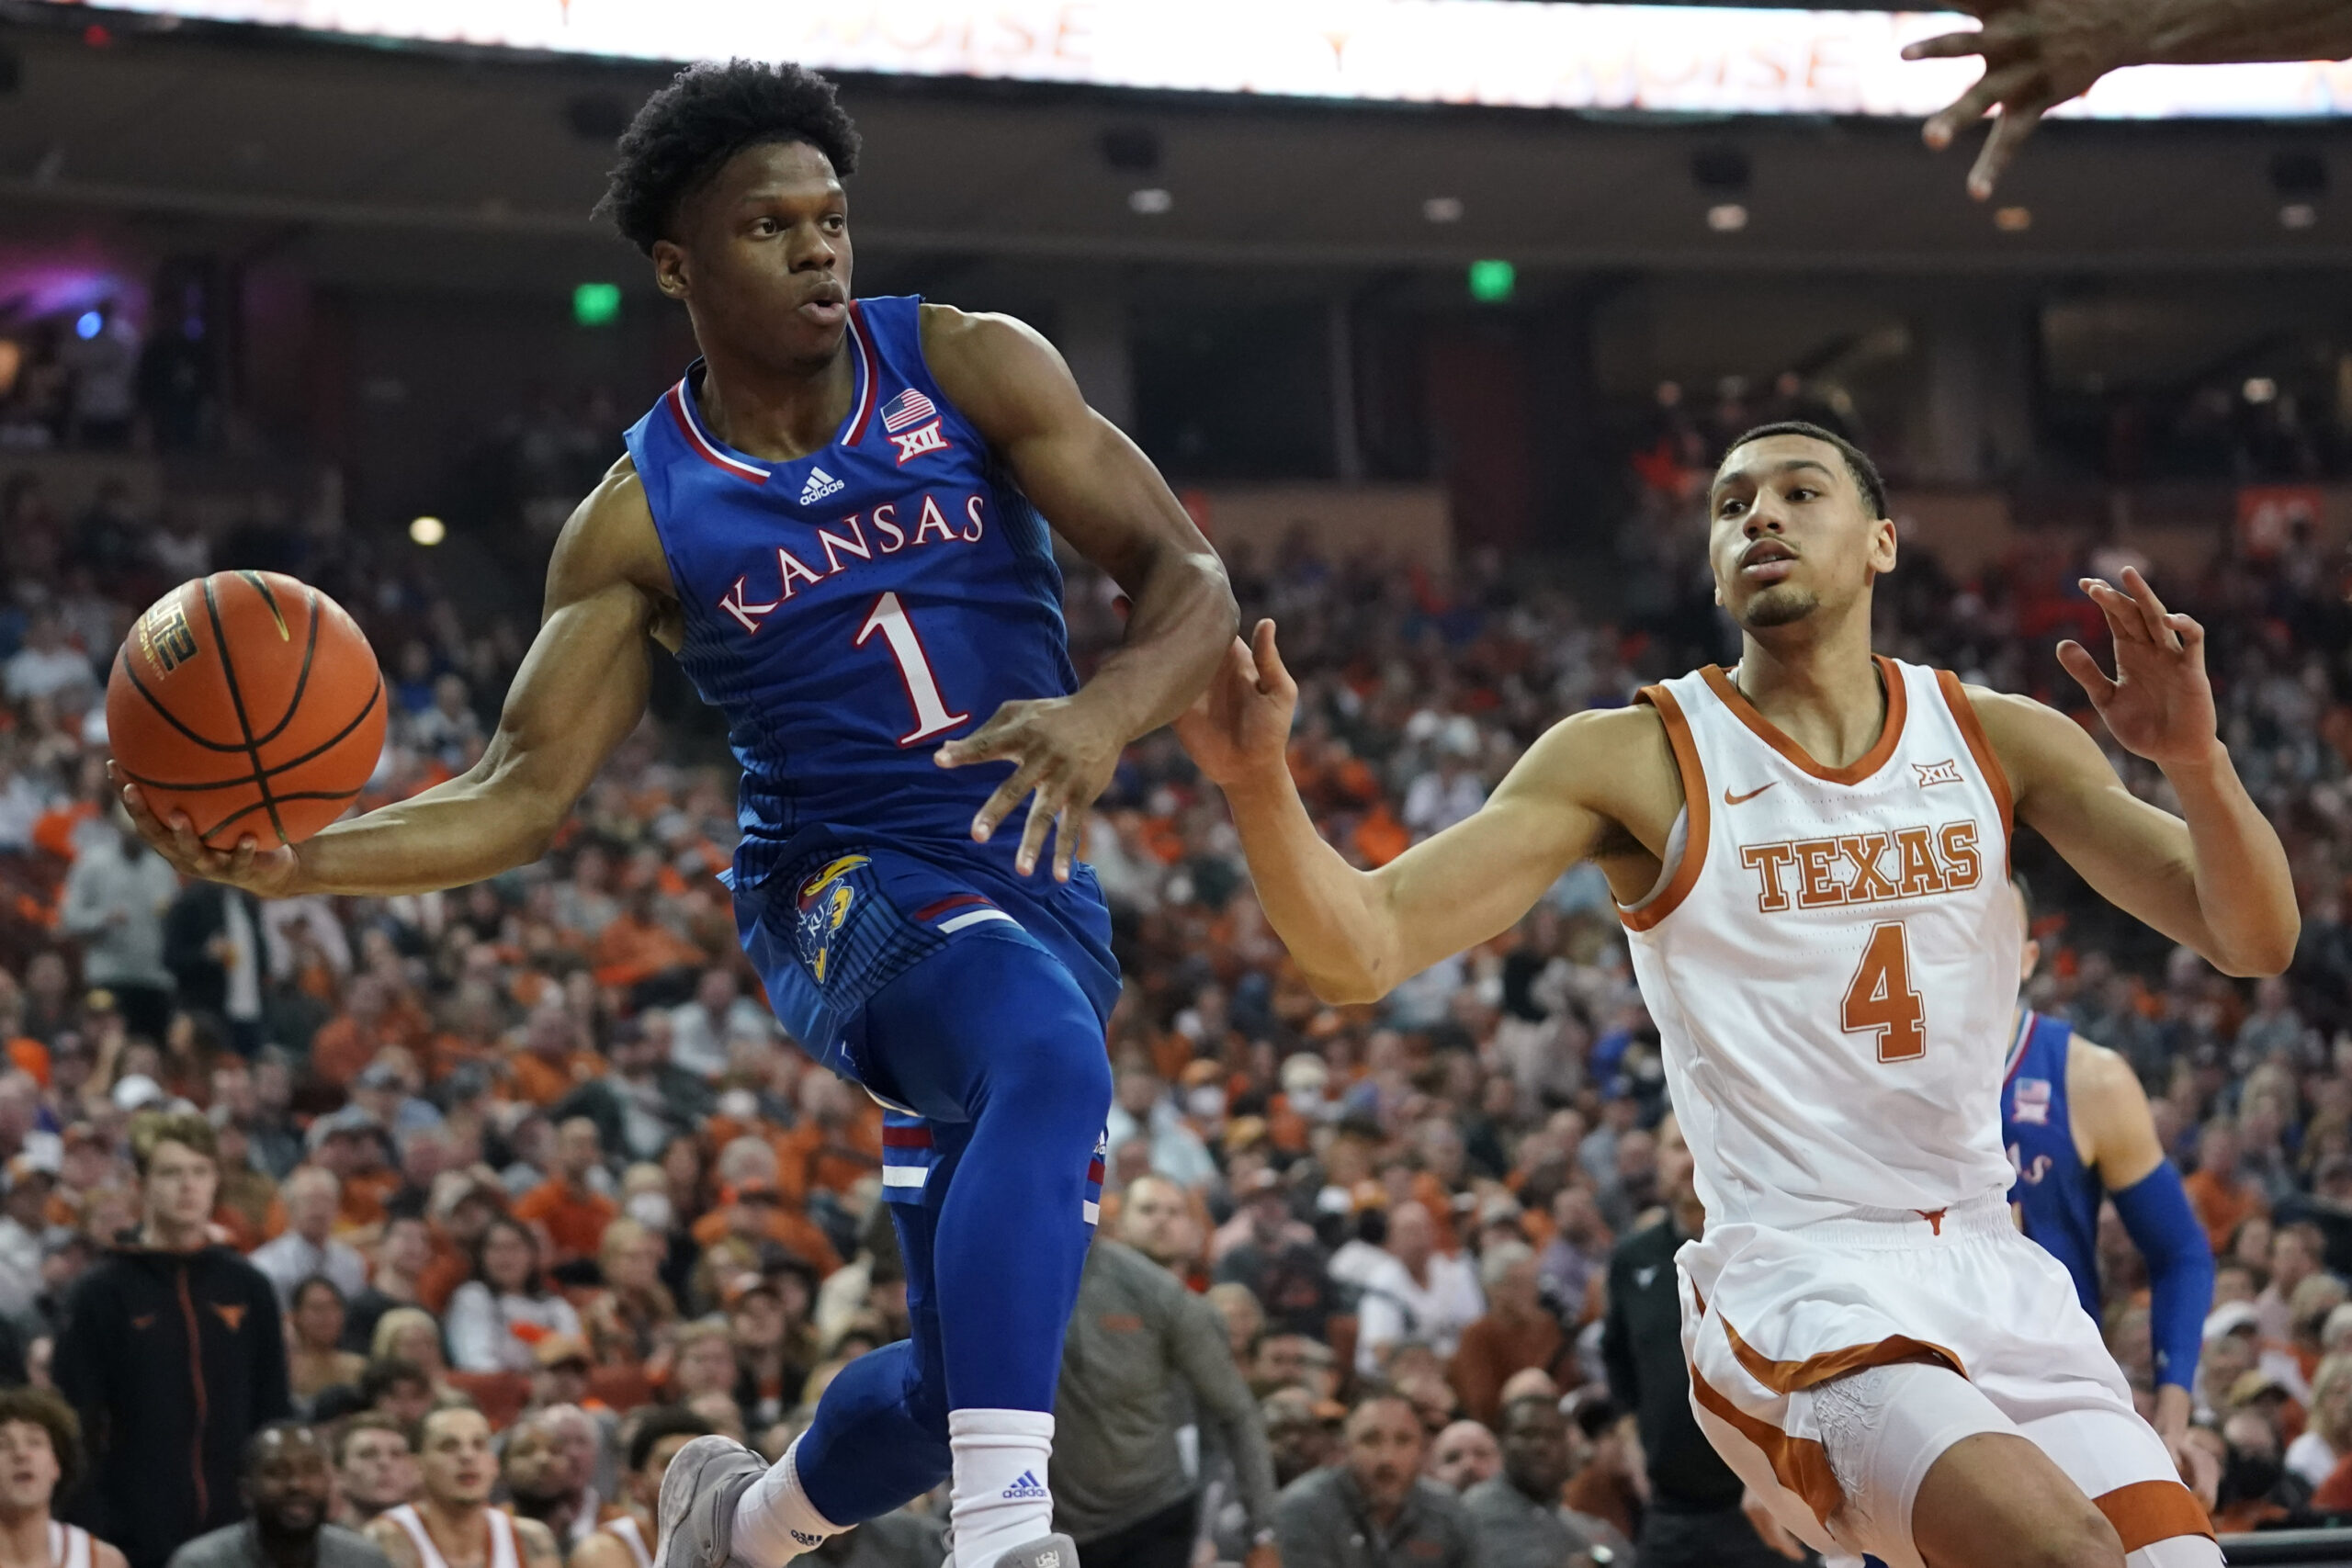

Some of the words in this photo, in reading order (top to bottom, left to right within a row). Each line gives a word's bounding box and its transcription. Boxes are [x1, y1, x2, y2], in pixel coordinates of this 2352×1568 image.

[886, 415, 954, 468] XII
[799, 479, 845, 506] adidas
[718, 493, 986, 635] KANSAS
[855, 591, 969, 747] 1
[1911, 759, 1963, 789] XII
[1739, 818, 1983, 913] TEXAS
[808, 904, 824, 938] KU
[1840, 920, 1926, 1064] 4
